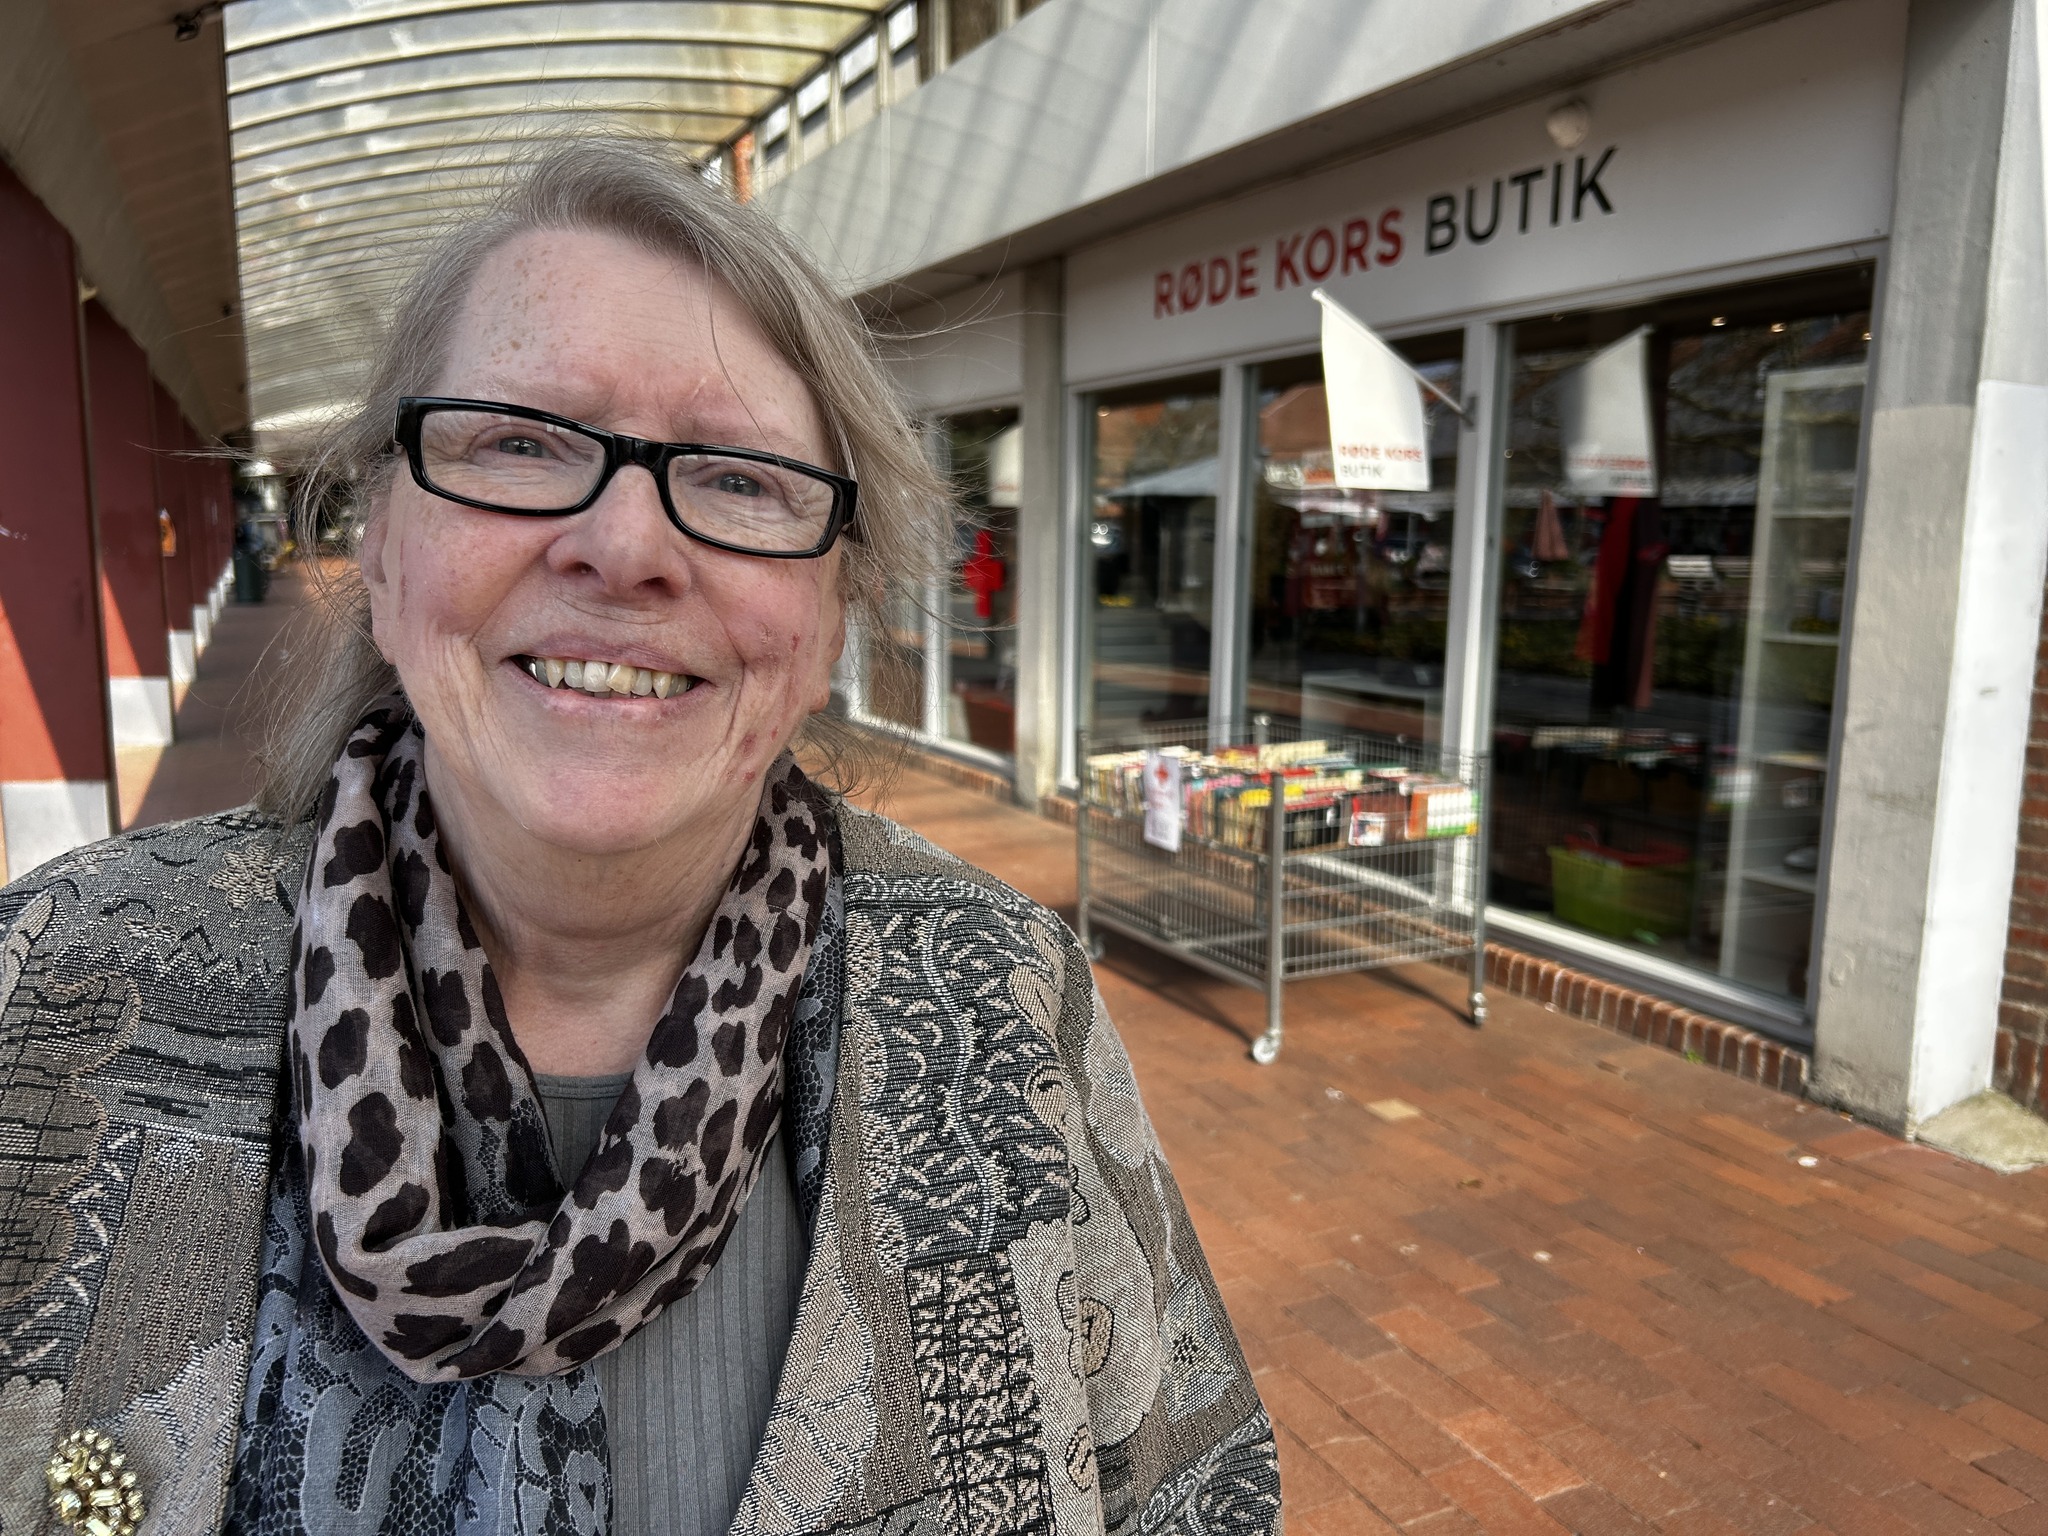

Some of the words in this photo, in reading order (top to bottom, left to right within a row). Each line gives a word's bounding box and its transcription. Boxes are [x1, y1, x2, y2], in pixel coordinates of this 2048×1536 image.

[1154, 246, 1260, 319] RØDE
[1274, 207, 1406, 291] KORS
[1424, 144, 1618, 257] BUTIK
